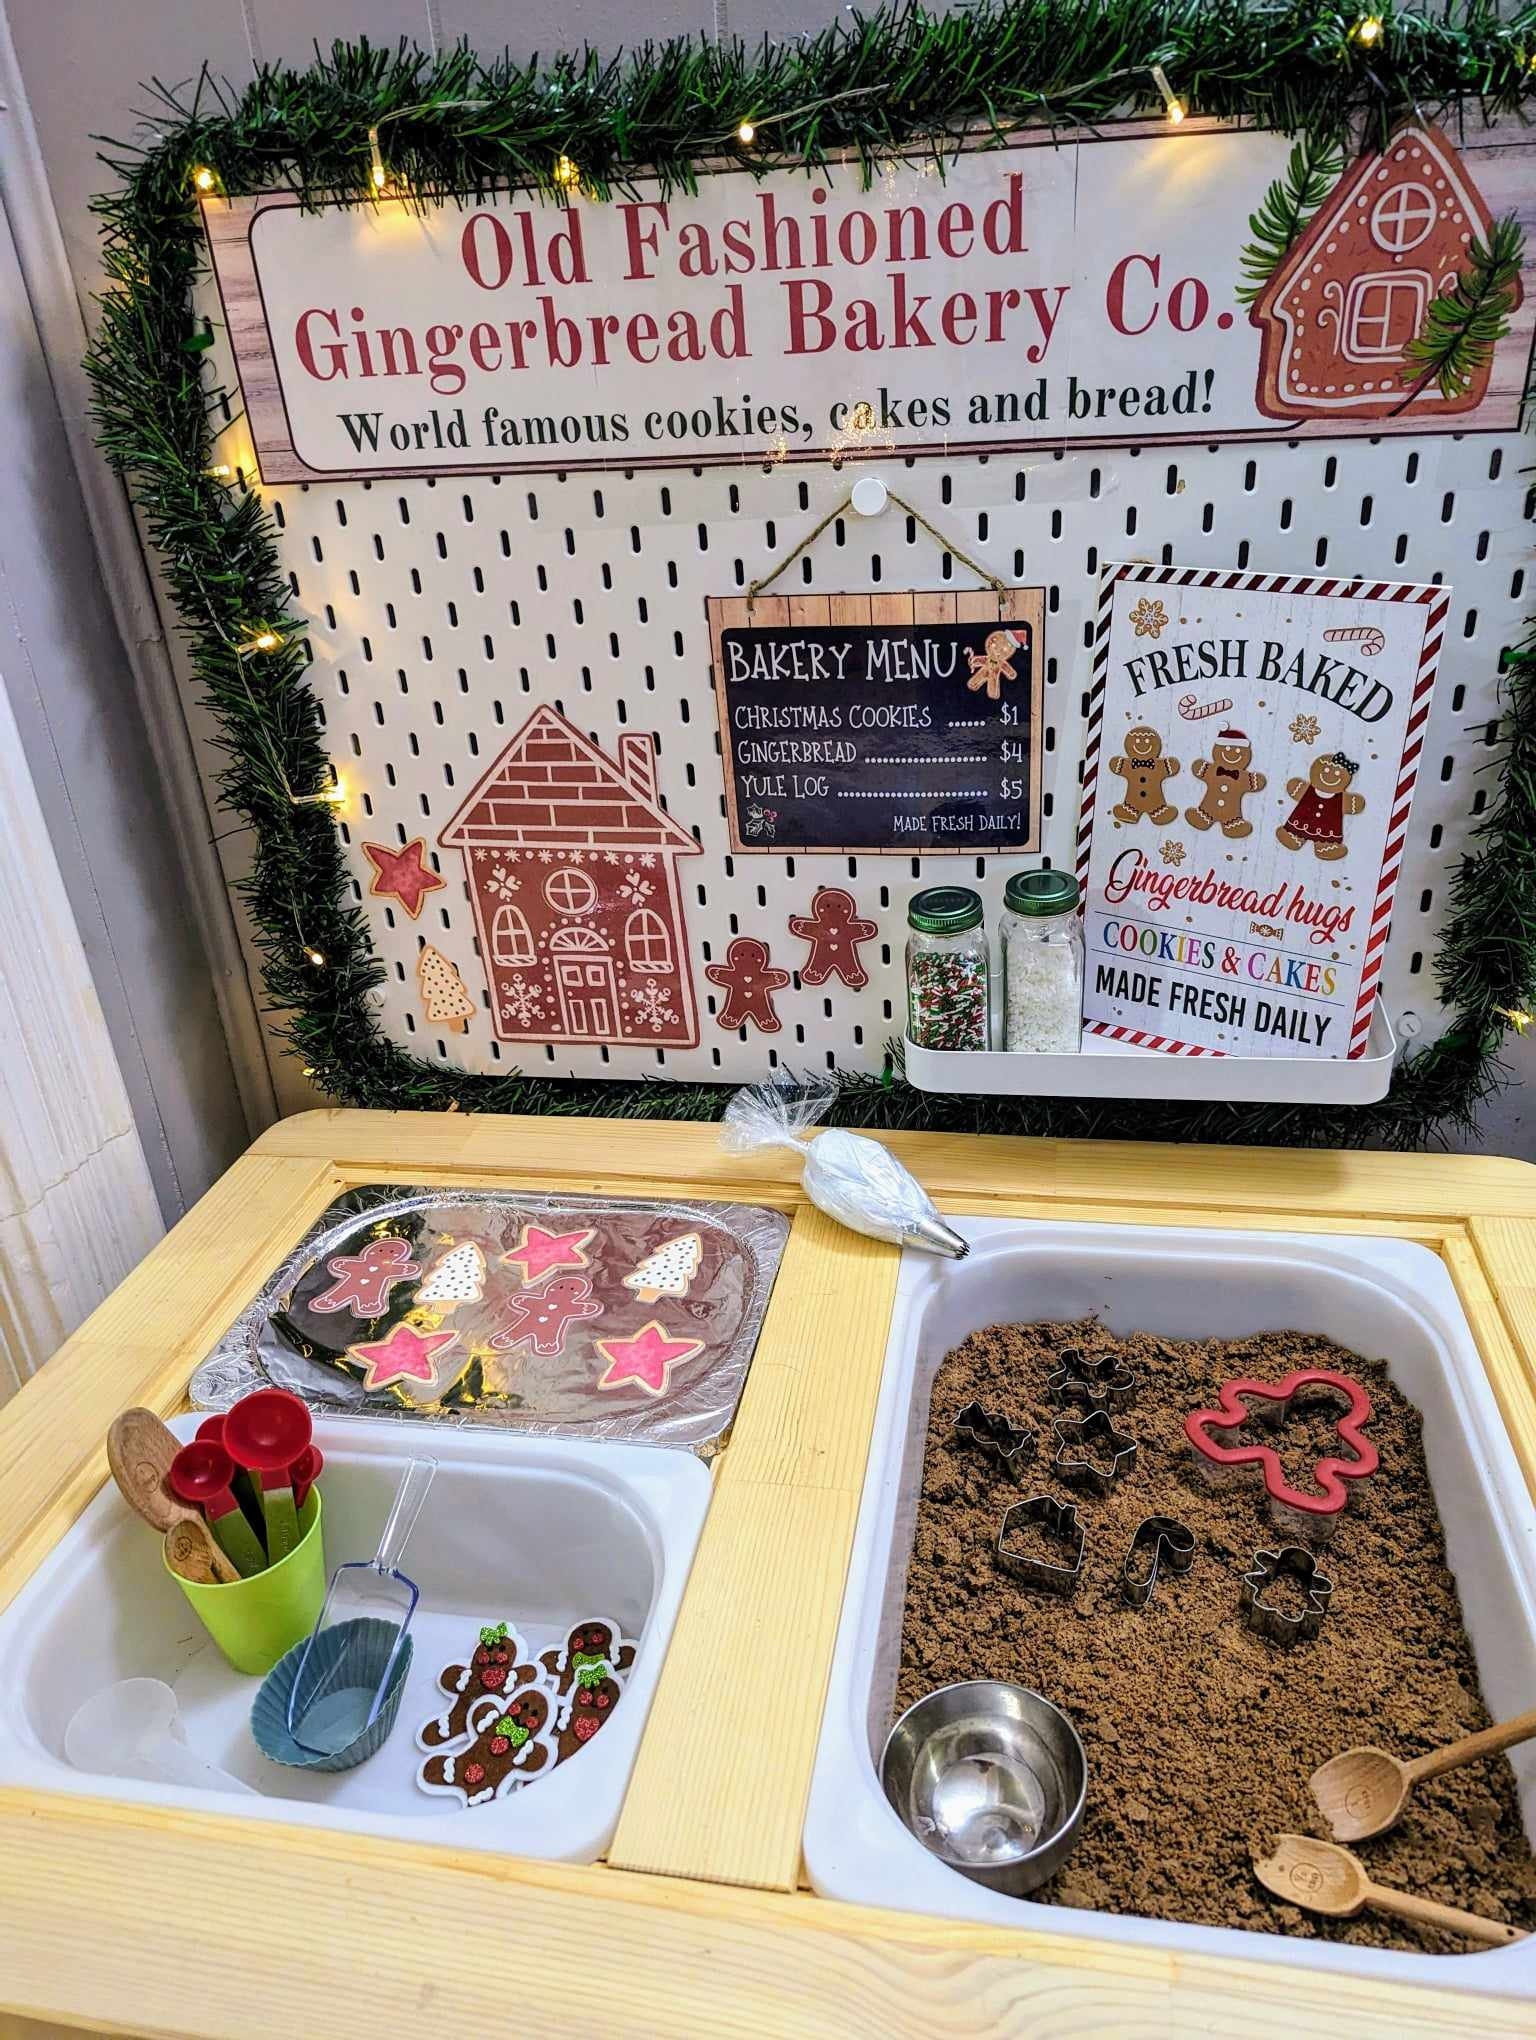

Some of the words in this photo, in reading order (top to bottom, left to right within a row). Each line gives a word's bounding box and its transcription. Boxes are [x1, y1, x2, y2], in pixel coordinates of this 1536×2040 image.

[461, 208, 593, 290] Old
[616, 172, 1029, 280] Fashioned
[294, 284, 753, 395] Gingerbread
[780, 272, 1071, 363] Bakery
[1106, 254, 1234, 336] Co.
[338, 409, 470, 454] World
[483, 405, 629, 447] famous
[644, 395, 814, 442] cookies,
[829, 387, 950, 431] cakes
[968, 379, 1049, 423] and
[1067, 368, 1215, 419] bread!
[727, 640, 852, 682] BAKERY
[865, 639, 958, 682] MENU
[1123, 639, 1249, 698] FRESH
[1256, 640, 1394, 724] BAKED
[735, 706, 842, 729] CHRISTMAS
[849, 705, 932, 729] COOKIES
[999, 703, 1019, 726] $1
[738, 740, 857, 764] GINGERBREAD
[999, 739, 1023, 763] $4
[741, 774, 787, 798] YULE
[792, 775, 829, 799] LOG
[999, 777, 1023, 800] $5
[893, 816, 927, 832] MADE
[932, 815, 974, 832] FRESH
[979, 813, 1021, 831] DAILY!
[1104, 848, 1287, 918] Gingerbread
[1285, 884, 1356, 945] hugs
[1103, 921, 1216, 970] COOKIES
[1221, 946, 1241, 977] &
[1247, 952, 1337, 996] CAKES
[1095, 964, 1162, 1009] MADE
[1168, 981, 1247, 1028] FRESH
[1254, 1001, 1332, 1047] DAILY
